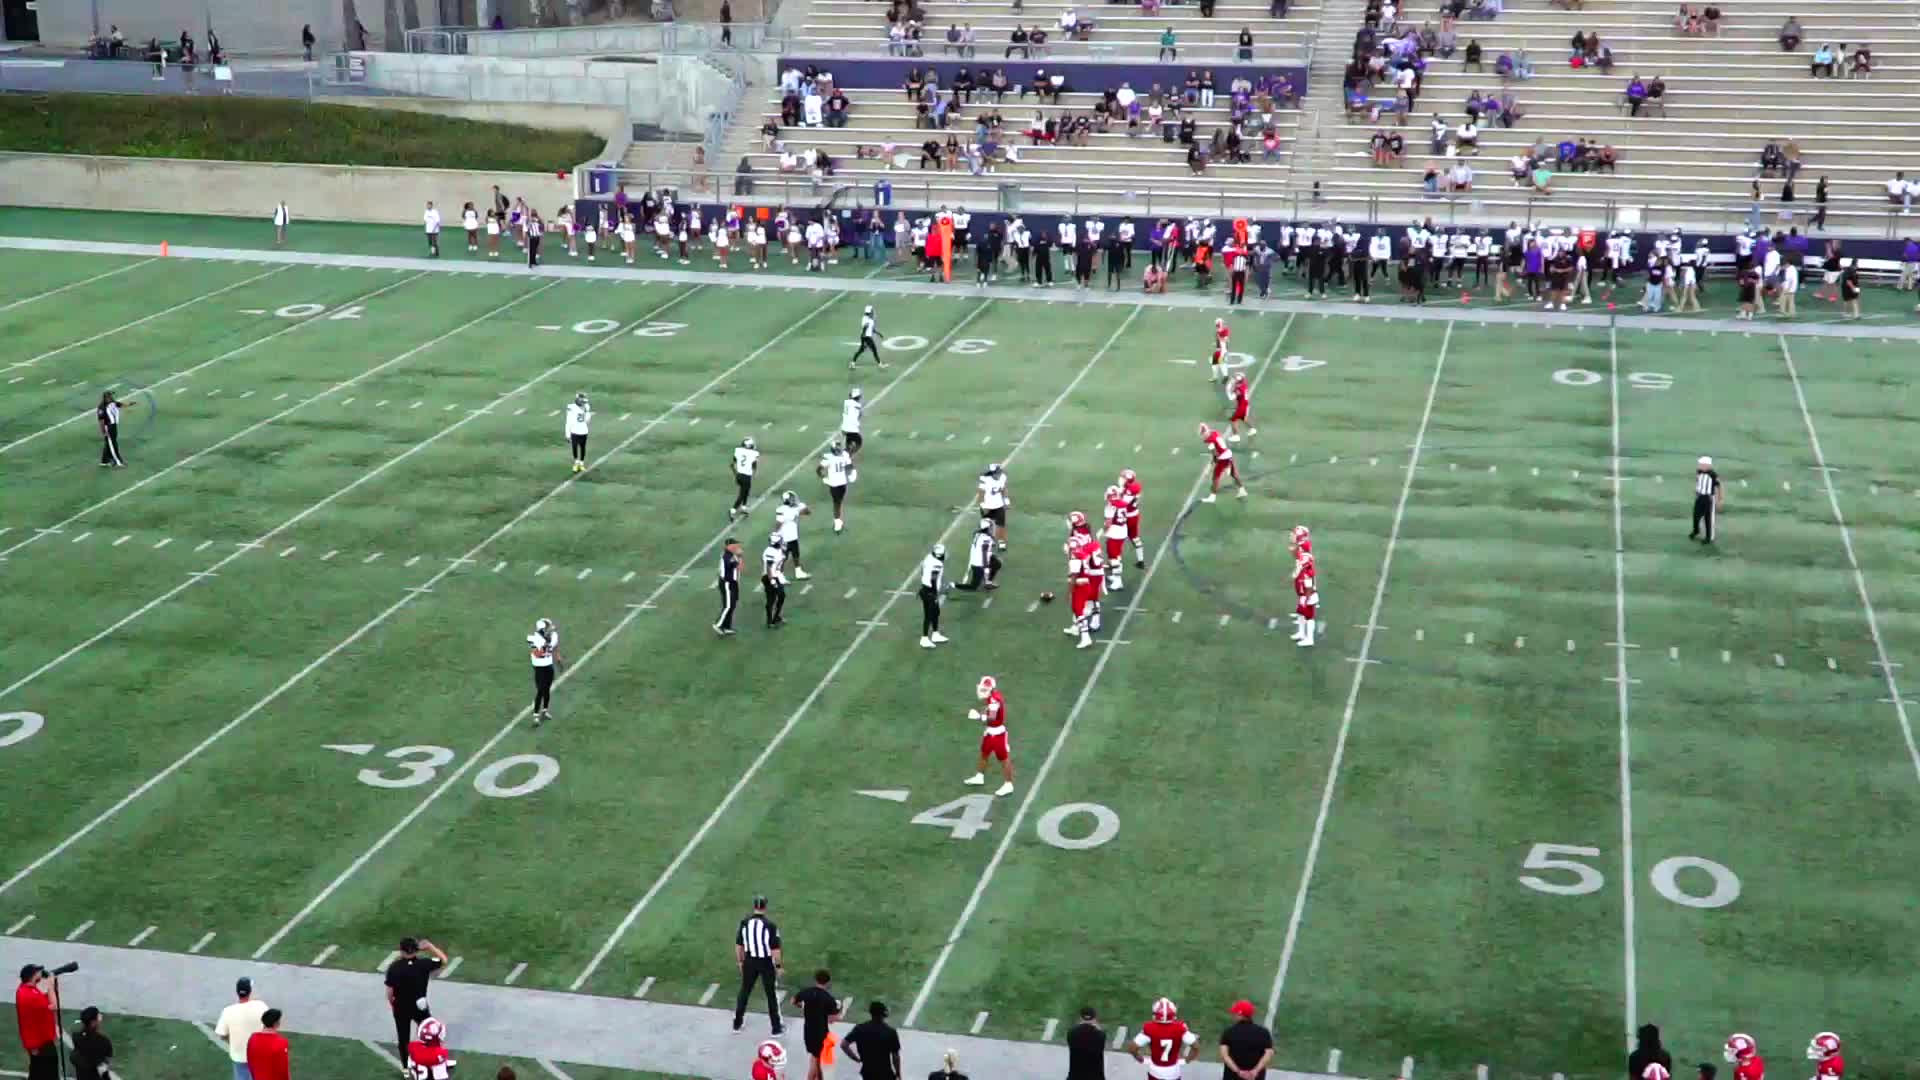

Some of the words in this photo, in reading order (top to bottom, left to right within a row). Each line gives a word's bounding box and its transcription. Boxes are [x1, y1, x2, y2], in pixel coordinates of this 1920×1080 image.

[357, 744, 560, 798] 30
[910, 794, 1121, 850] 40
[1519, 843, 1742, 909] 50
[1160, 1039, 1173, 1062] 7
